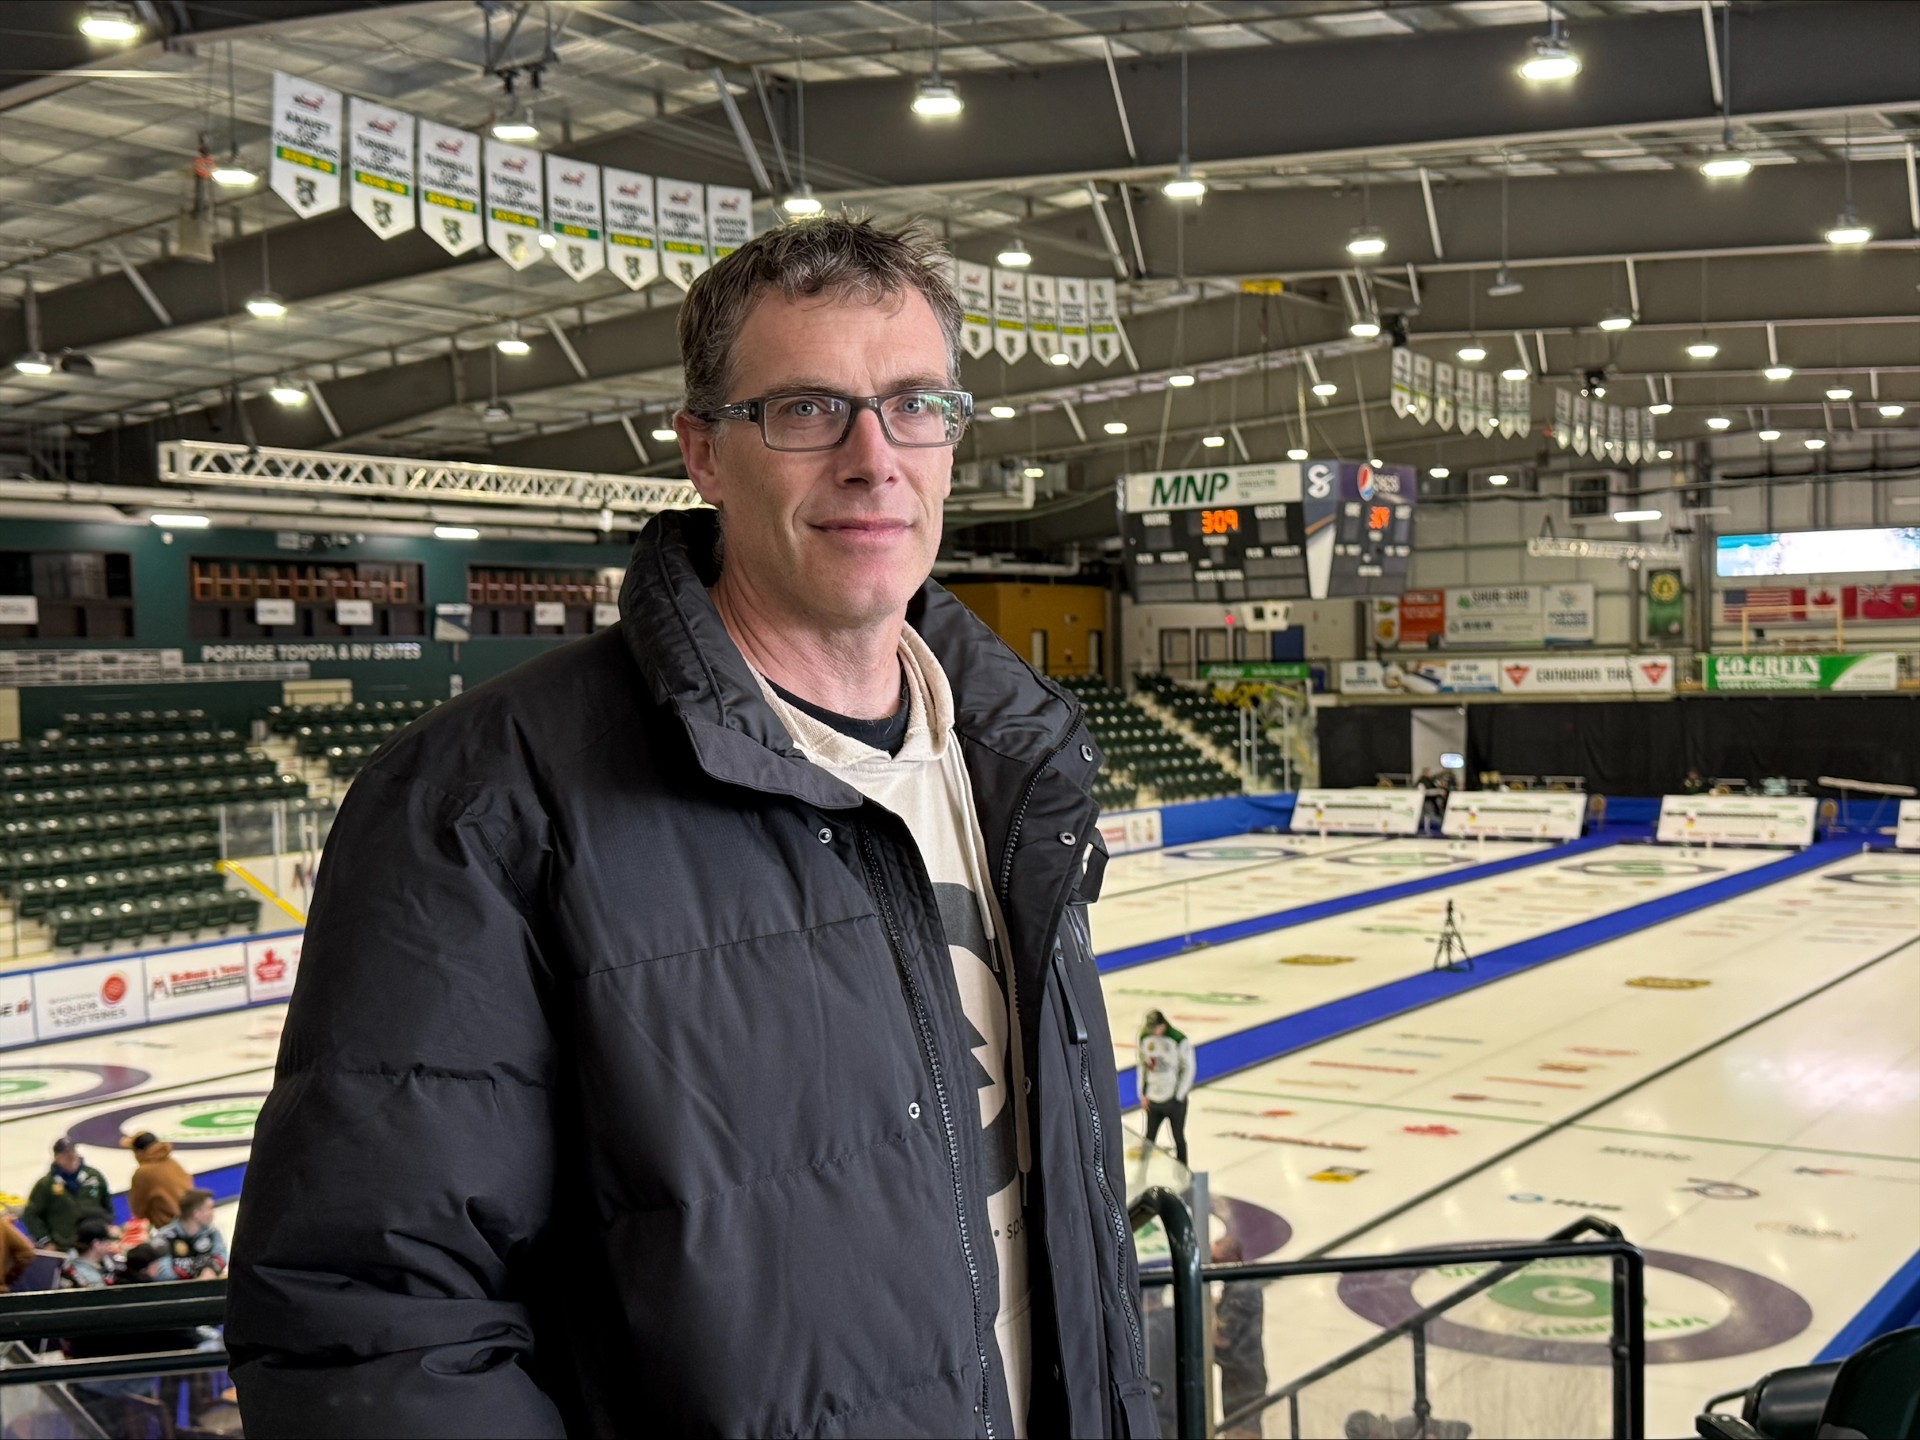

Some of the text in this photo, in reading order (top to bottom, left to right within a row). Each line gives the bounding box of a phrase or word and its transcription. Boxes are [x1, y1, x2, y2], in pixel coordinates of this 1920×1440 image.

[1151, 472, 1229, 507] MNP
[202, 642, 422, 662] PORTAGE TOYOTA & RV SUITES
